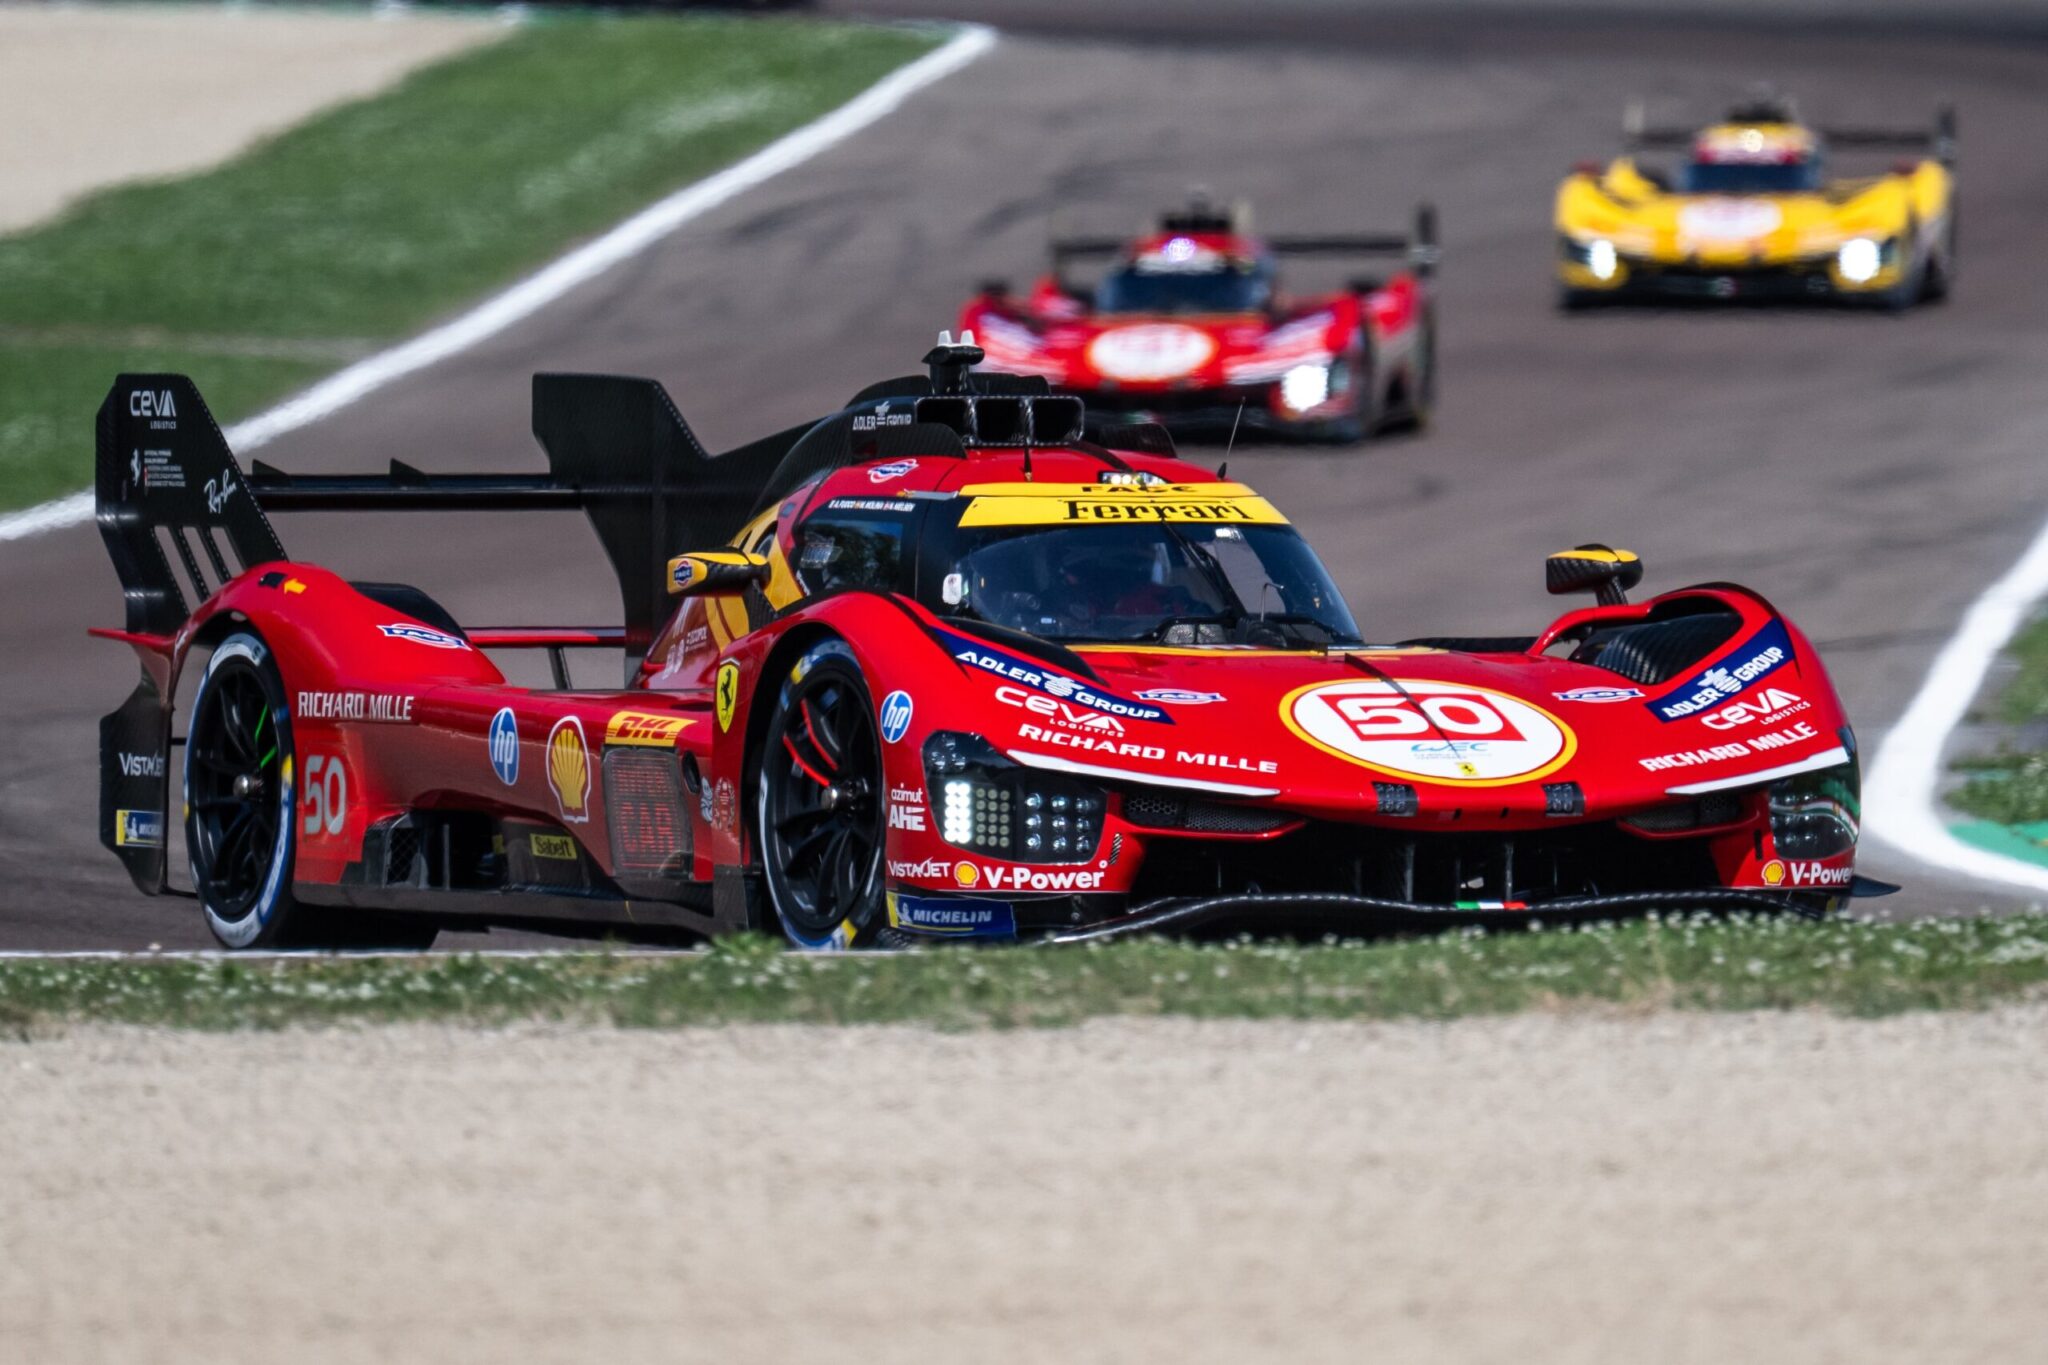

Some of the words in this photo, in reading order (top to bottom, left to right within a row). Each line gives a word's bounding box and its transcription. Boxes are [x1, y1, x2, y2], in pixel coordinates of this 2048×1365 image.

[852, 415, 876, 431] ADLER
[1064, 499, 1254, 520] Ferrari
[956, 650, 1041, 686] ADLER
[1074, 692, 1160, 719] GROUP
[1662, 687, 1725, 718] ADLER
[1733, 646, 1785, 682] GROUP
[298, 692, 365, 719] RICHARD
[369, 694, 415, 720] MILLE
[884, 692, 910, 742] hp
[1336, 696, 1504, 736] 50
[1760, 701, 1811, 725] LOGISTICS
[615, 716, 676, 738] DHL
[1048, 718, 1125, 738] LOGISTICS
[1018, 722, 1166, 760] RICHARD
[1176, 750, 1278, 774] MILLE
[1638, 742, 1751, 772] RICHARD
[1747, 721, 1819, 751] MILLE
[304, 755, 347, 835] 50
[891, 782, 923, 803] azimut
[888, 804, 926, 831] AHE
[983, 866, 1104, 889] V-Power
[913, 908, 993, 923] MICHELIN
